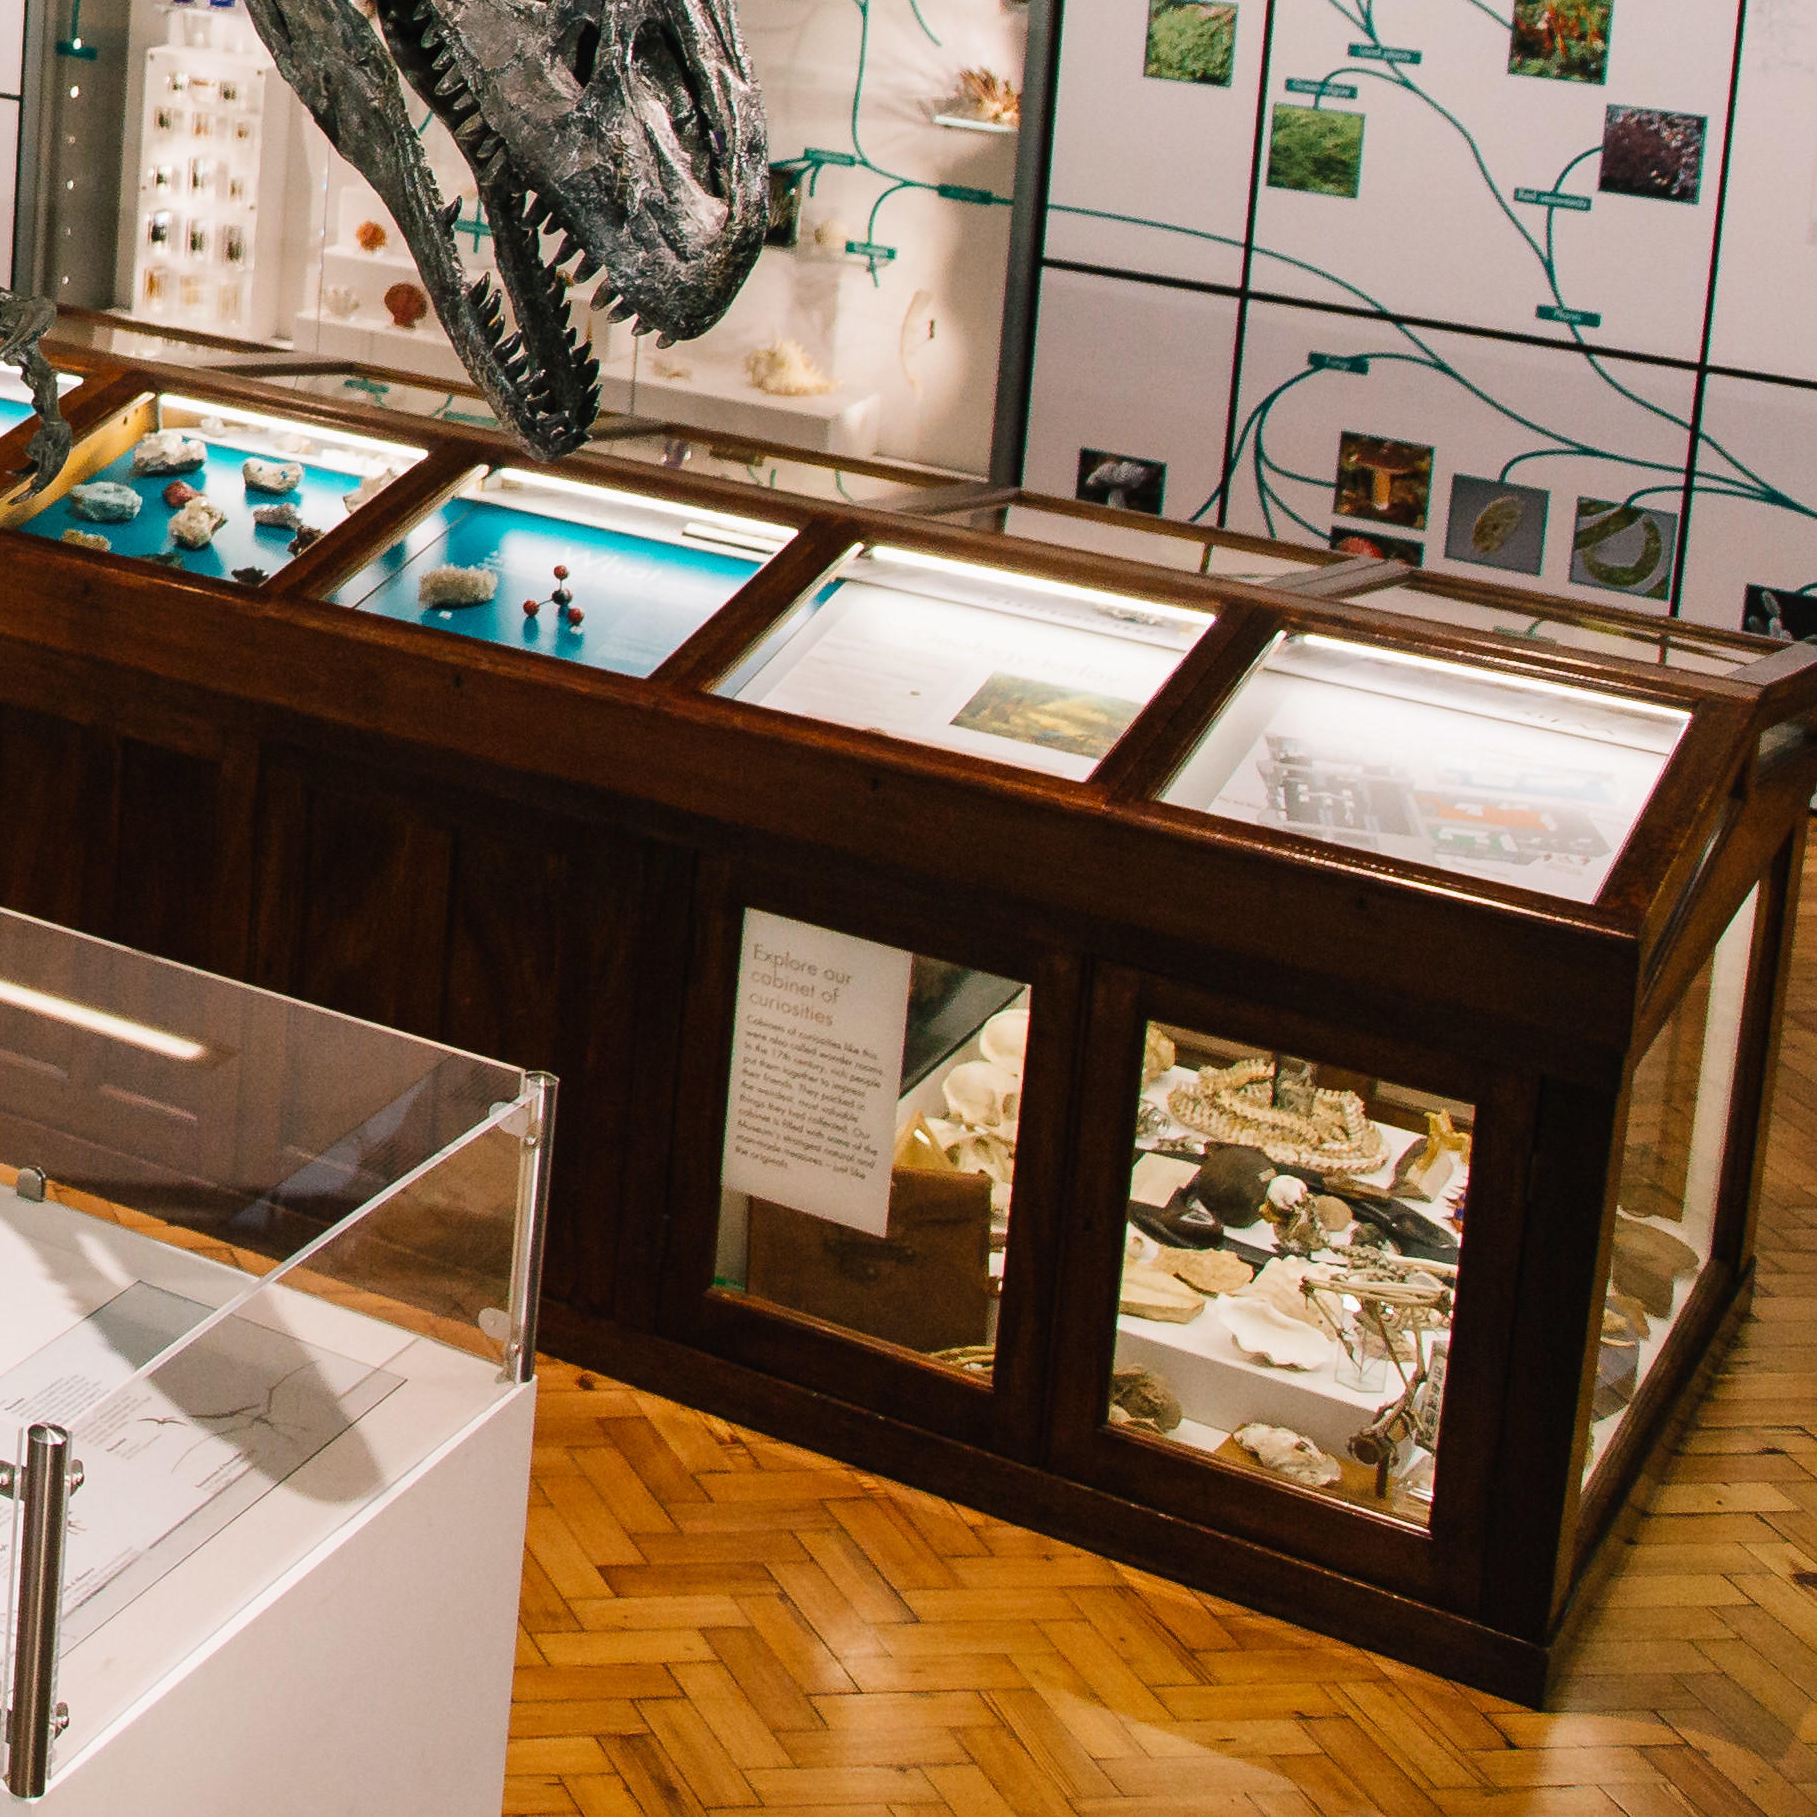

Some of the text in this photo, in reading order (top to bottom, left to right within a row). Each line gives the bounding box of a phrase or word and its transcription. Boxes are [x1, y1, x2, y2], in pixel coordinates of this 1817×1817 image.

[753, 943, 852, 985] Explore our
[751, 969, 840, 1003] cabinet of
[749, 993, 833, 1026] curiosities
